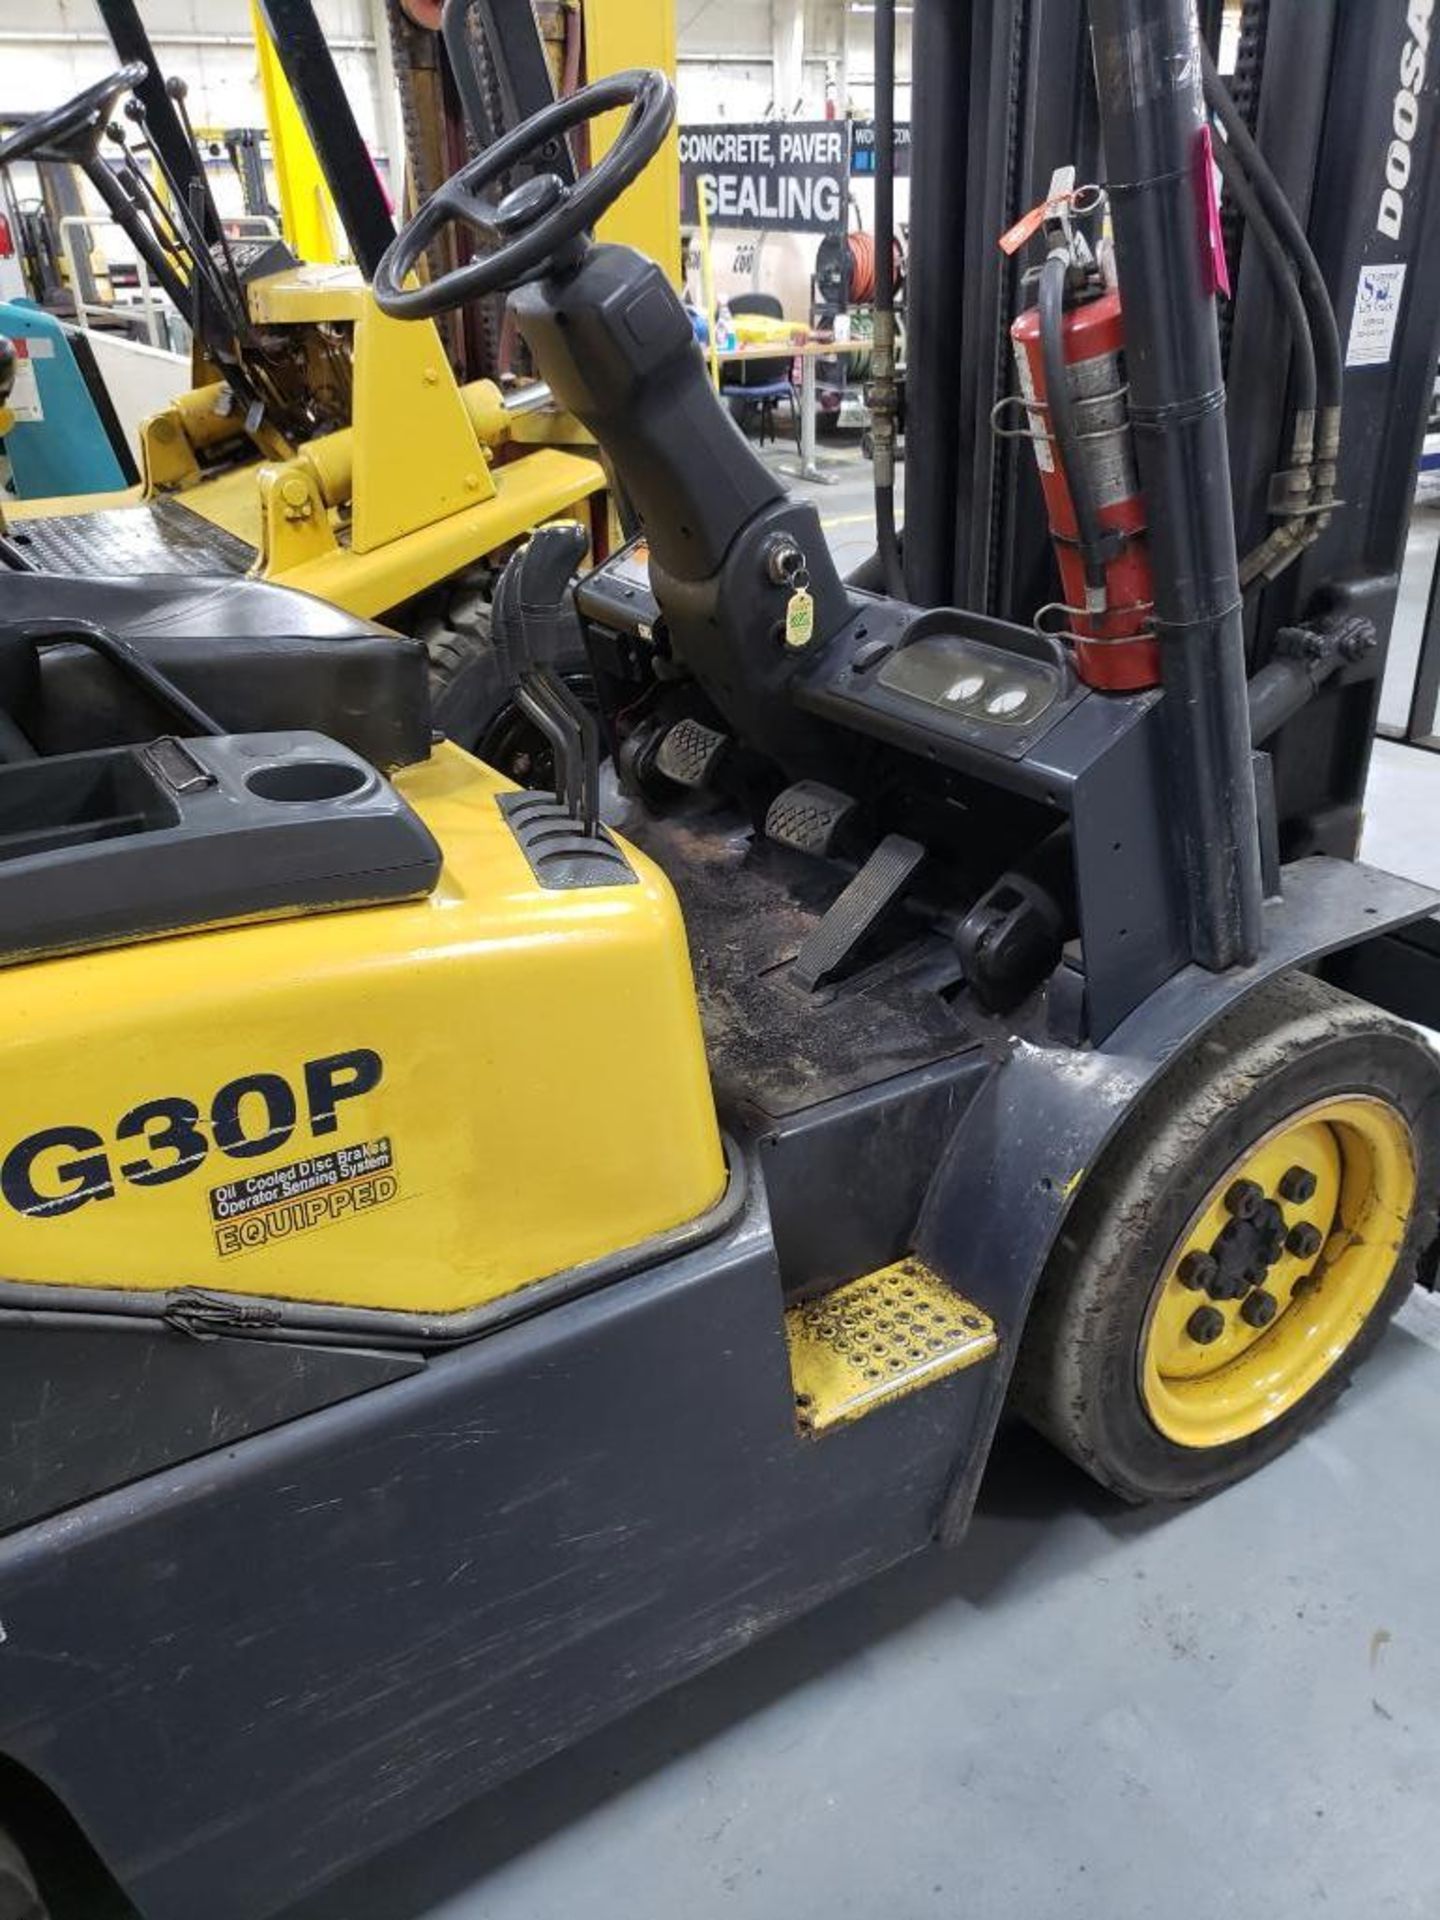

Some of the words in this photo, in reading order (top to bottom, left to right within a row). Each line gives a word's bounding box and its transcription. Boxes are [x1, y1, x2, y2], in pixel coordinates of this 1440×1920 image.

[678, 133, 775, 168] CONCRETE,
[780, 132, 842, 164] PAVER
[699, 173, 841, 221] SEALING
[1, 1048, 383, 1218] G30P
[216, 1186, 236, 1202] Oil
[246, 1166, 296, 1193] Cooled
[299, 1158, 333, 1175] Disc
[337, 1139, 388, 1165] Brakes
[217, 1189, 278, 1216] Operator
[282, 1170, 338, 1197] Sensing
[340, 1154, 389, 1180] System
[215, 1175, 398, 1256] EQUIPPED
